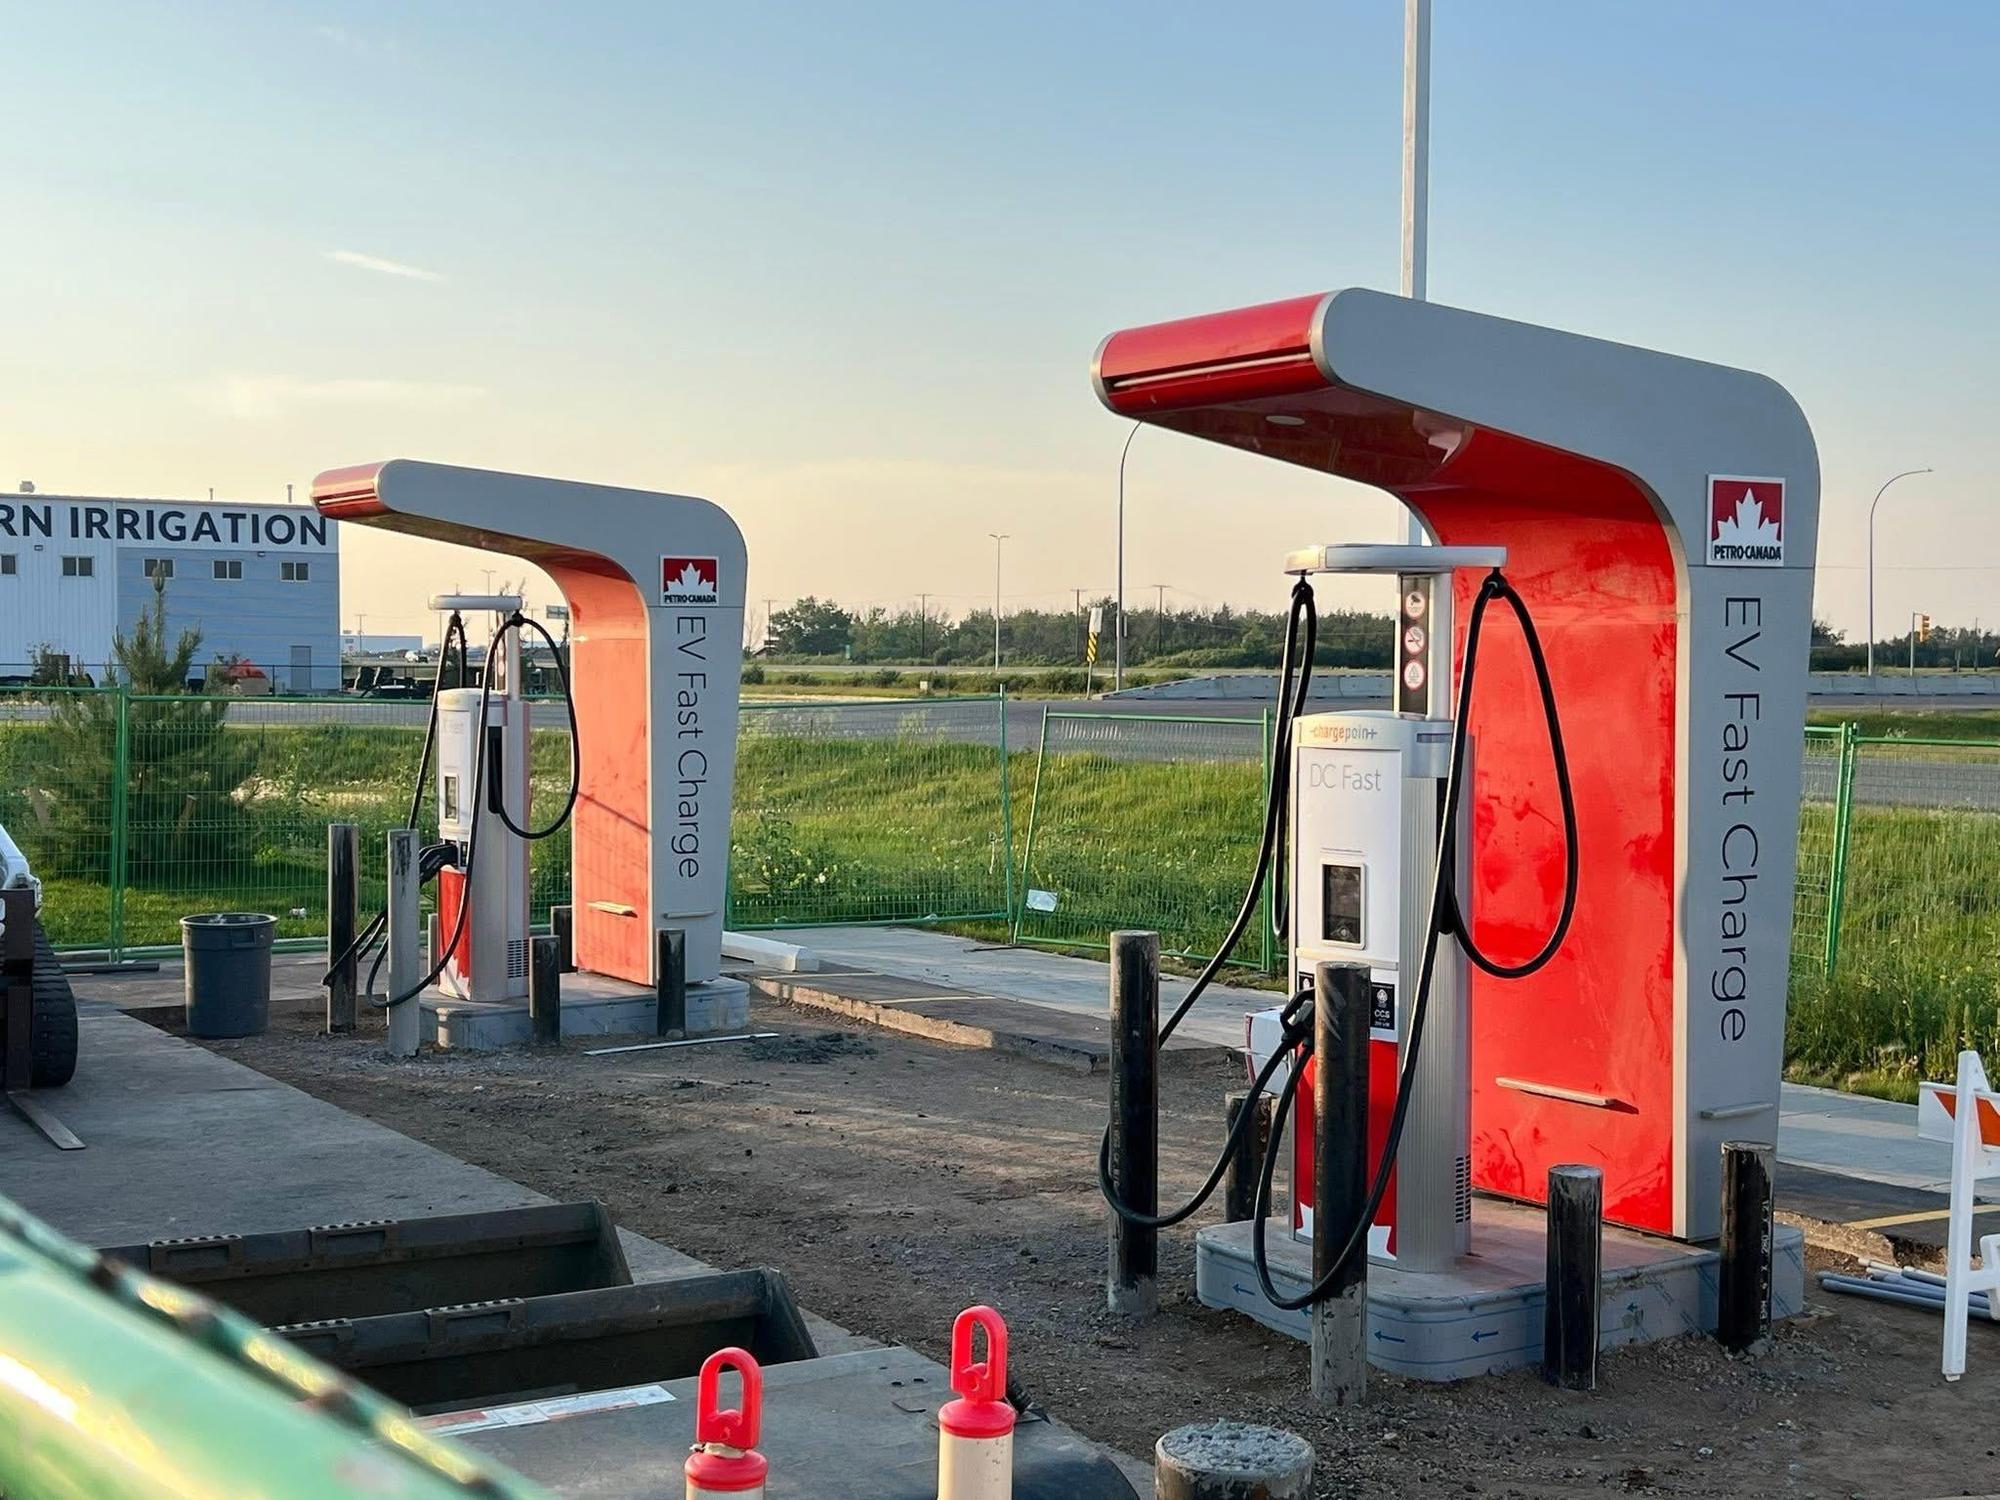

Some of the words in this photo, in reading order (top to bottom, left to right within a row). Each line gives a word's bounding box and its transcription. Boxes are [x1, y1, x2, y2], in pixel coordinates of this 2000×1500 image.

[70, 506, 326, 546] IRRIGATION
[677, 616, 706, 660] EV
[1723, 597, 1761, 672] EV
[678, 672, 706, 740] Fast
[1310, 763, 1337, 788] DC
[1342, 764, 1382, 792] Fast
[1722, 693, 1760, 806] Fast
[671, 749, 708, 878] Charge
[1712, 824, 1759, 1043] Charge
